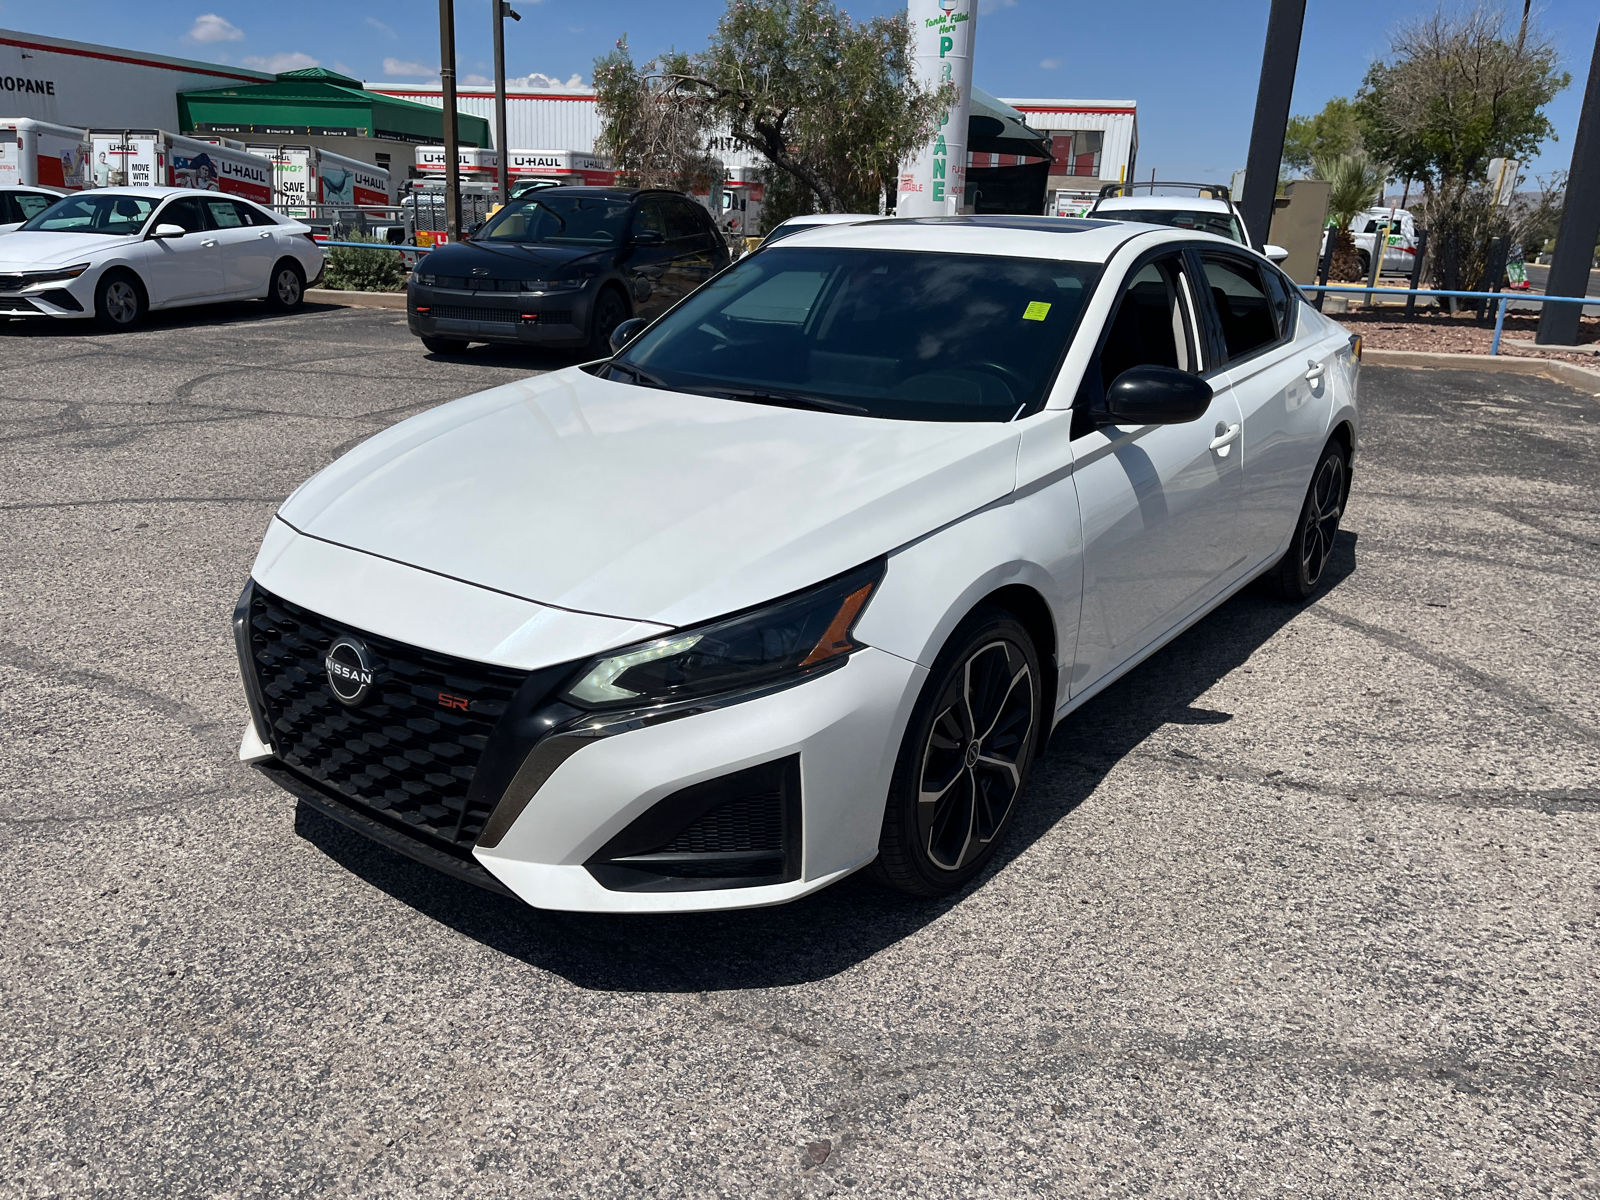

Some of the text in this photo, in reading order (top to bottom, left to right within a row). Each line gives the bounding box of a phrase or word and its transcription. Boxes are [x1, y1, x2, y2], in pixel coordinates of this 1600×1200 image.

[925, 11, 969, 28] Tanks Filled
[939, 25, 957, 35] Here
[932, 36, 954, 202] PRPANE
[131, 163, 150, 172] MOVE
[514, 157, 561, 167] U-HAUL
[132, 172, 149, 180] WITH
[221, 161, 266, 183] U-HAUL
[283, 181, 305, 193] SAVE
[354, 172, 386, 191] U-HAUL
[284, 195, 306, 206] 75%
[325, 657, 372, 684] NISSAN
[438, 692, 469, 712] SR
